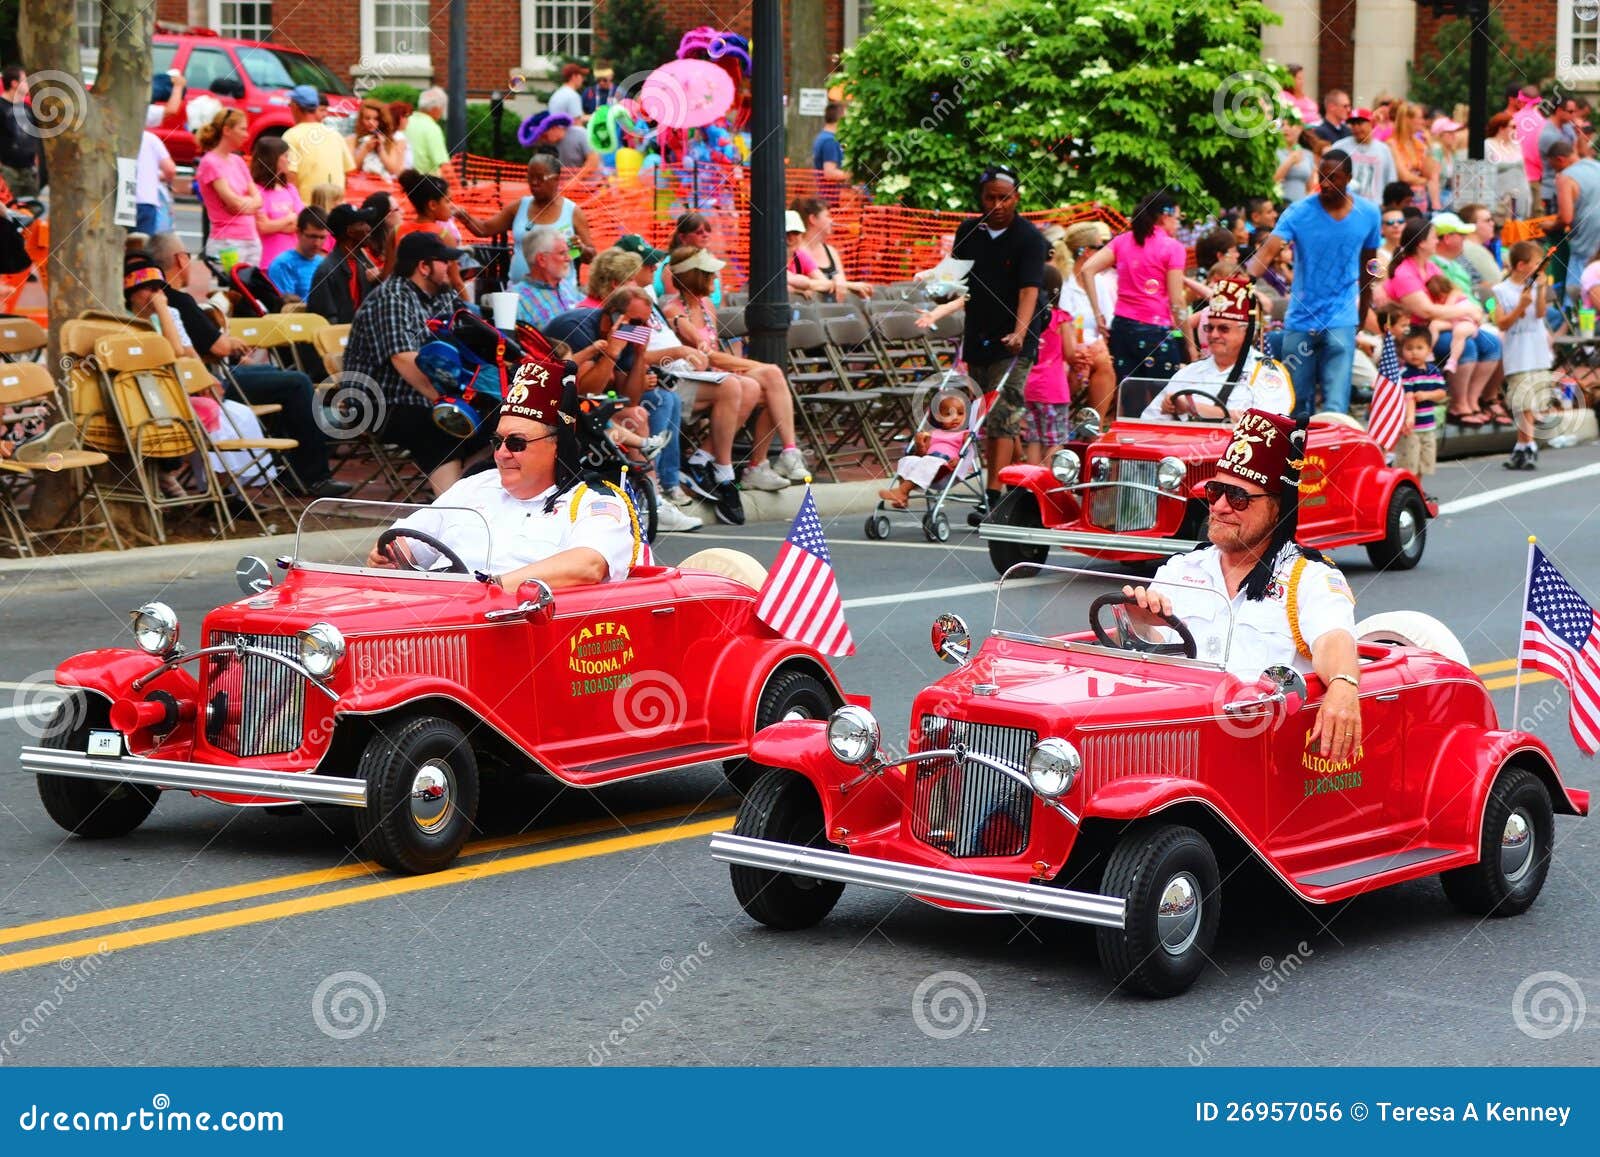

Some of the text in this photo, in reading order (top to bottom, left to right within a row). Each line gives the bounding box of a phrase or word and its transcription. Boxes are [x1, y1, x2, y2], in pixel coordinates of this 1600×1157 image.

[512, 405, 543, 419] CORPS
[1233, 464, 1269, 484] CORPS
[570, 622, 631, 654] JAFFA
[577, 638, 625, 658] MOTOR CORPS
[569, 646, 634, 674] ALTOONA, PA
[572, 673, 632, 696] 32 ROADSTERS
[99, 738, 111, 749] ART
[1304, 771, 1362, 797] 32 ROADSTERS
